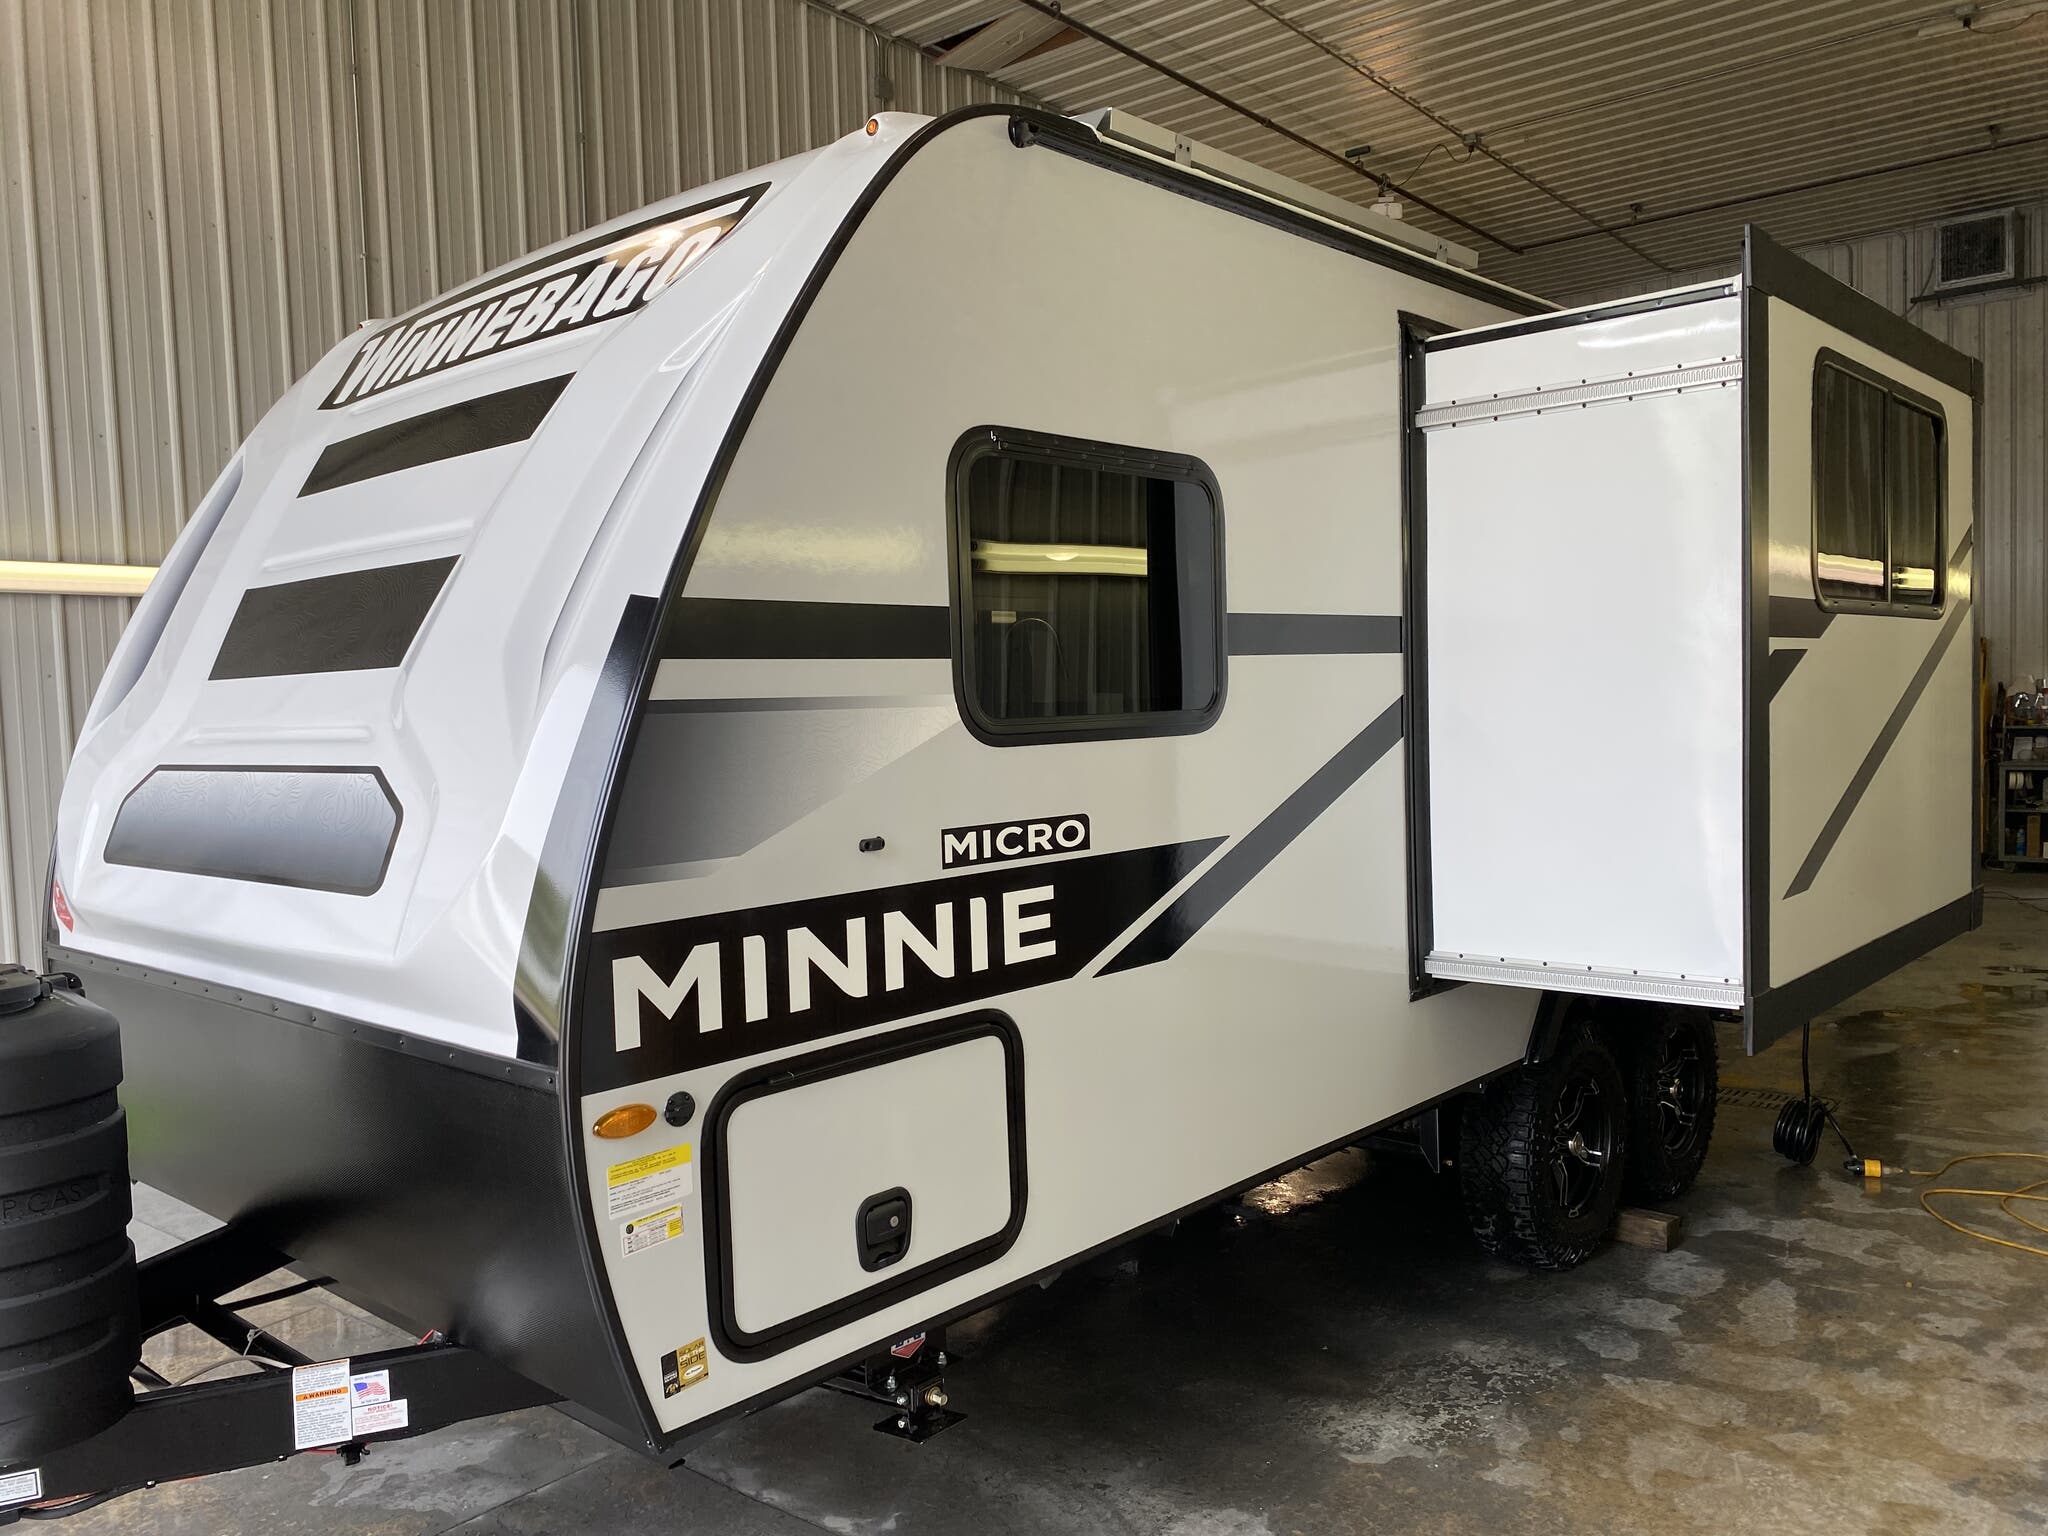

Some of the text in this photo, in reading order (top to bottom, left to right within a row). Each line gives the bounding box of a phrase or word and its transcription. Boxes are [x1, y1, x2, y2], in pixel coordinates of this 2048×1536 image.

[333, 226, 723, 405] WINNEBAGO
[943, 819, 1086, 864] MICRO
[612, 885, 1057, 1052] MINNIE
[27, 1183, 81, 1213] GAS
[680, 1351, 704, 1368] SIDE
[309, 1388, 342, 1398] WARNING
